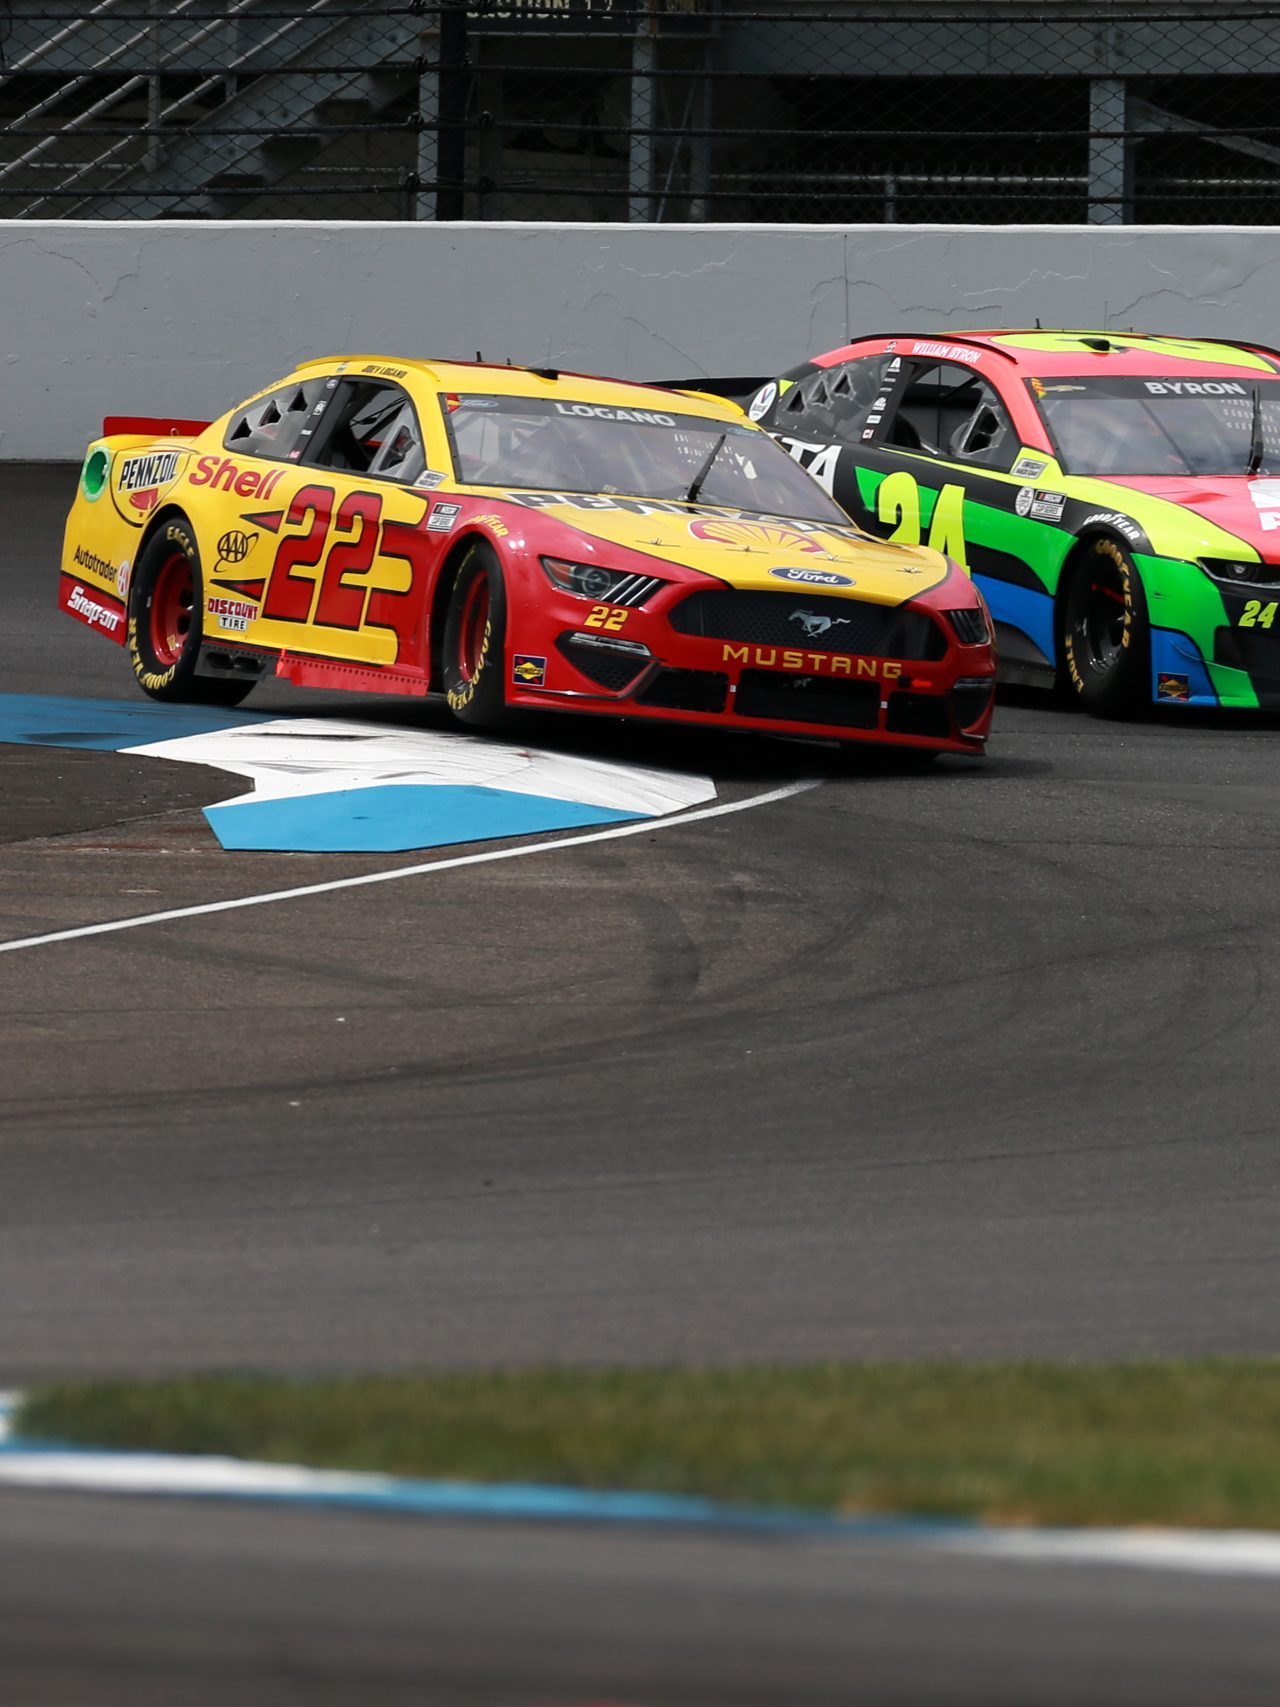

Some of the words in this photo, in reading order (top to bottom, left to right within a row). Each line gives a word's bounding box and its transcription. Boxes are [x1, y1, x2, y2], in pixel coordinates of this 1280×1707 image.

[911, 342, 948, 357] WILLIAM
[948, 347, 982, 364] BYRON
[1144, 381, 1248, 396] BYRON
[554, 402, 677, 428] LOGANO
[118, 451, 180, 493] PENNZOIL
[189, 455, 288, 501] Shell
[878, 471, 972, 579] 24
[218, 531, 248, 563] AAA
[262, 484, 384, 632] 22
[73, 543, 118, 584] Autotrader
[67, 585, 120, 632] Snap-on
[207, 597, 259, 621] DISCOUNT
[221, 616, 246, 630] TIRE
[584, 605, 630, 632] 22
[1238, 599, 1279, 629] 24
[722, 643, 904, 680] MUSTANG
